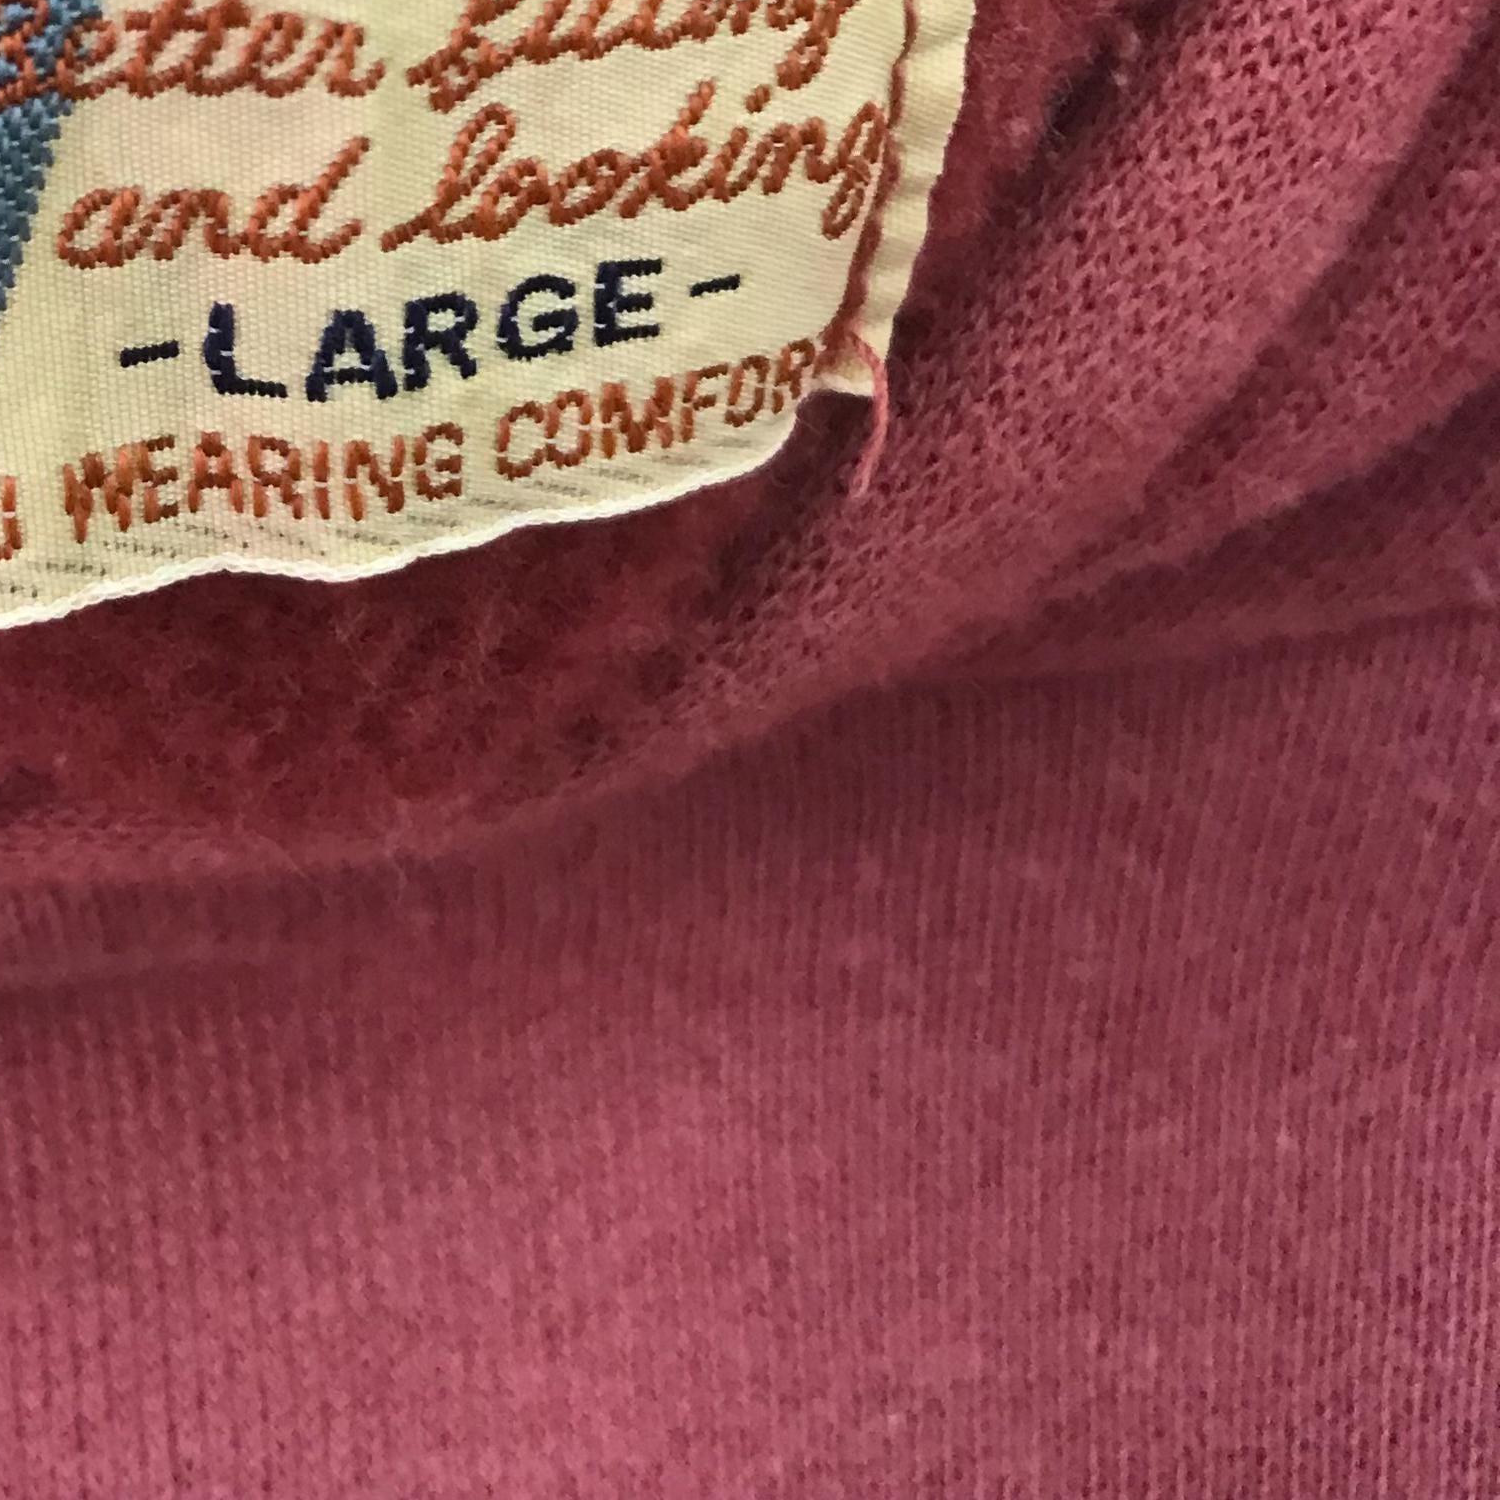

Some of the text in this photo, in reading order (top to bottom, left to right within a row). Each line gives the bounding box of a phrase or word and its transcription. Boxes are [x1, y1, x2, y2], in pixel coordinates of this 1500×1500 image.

[54, 80, 888, 270] and looking
[62, 420, 468, 546] WEARING
[496, 334, 818, 482] COMFOR
